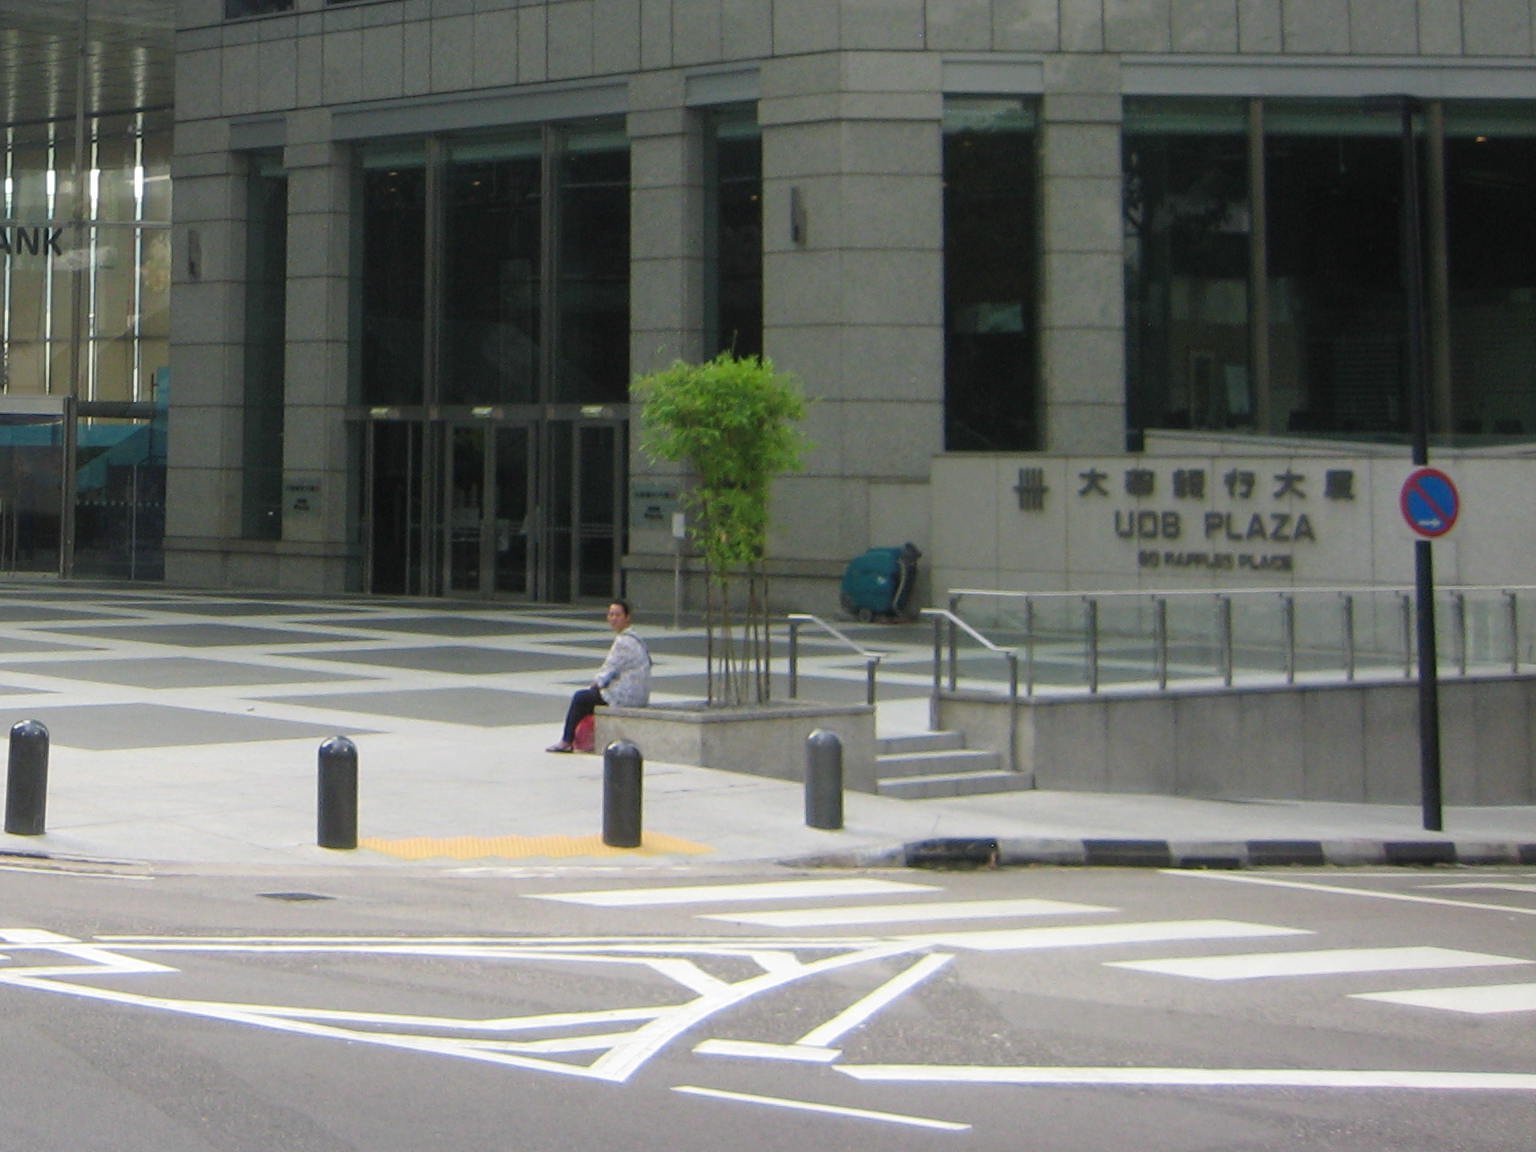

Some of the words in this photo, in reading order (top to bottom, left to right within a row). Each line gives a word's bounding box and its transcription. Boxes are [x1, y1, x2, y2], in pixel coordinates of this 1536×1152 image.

[1114, 510, 1181, 539] UOB
[1204, 512, 1316, 542] PLAZA
[1238, 553, 1294, 571] PLACE
